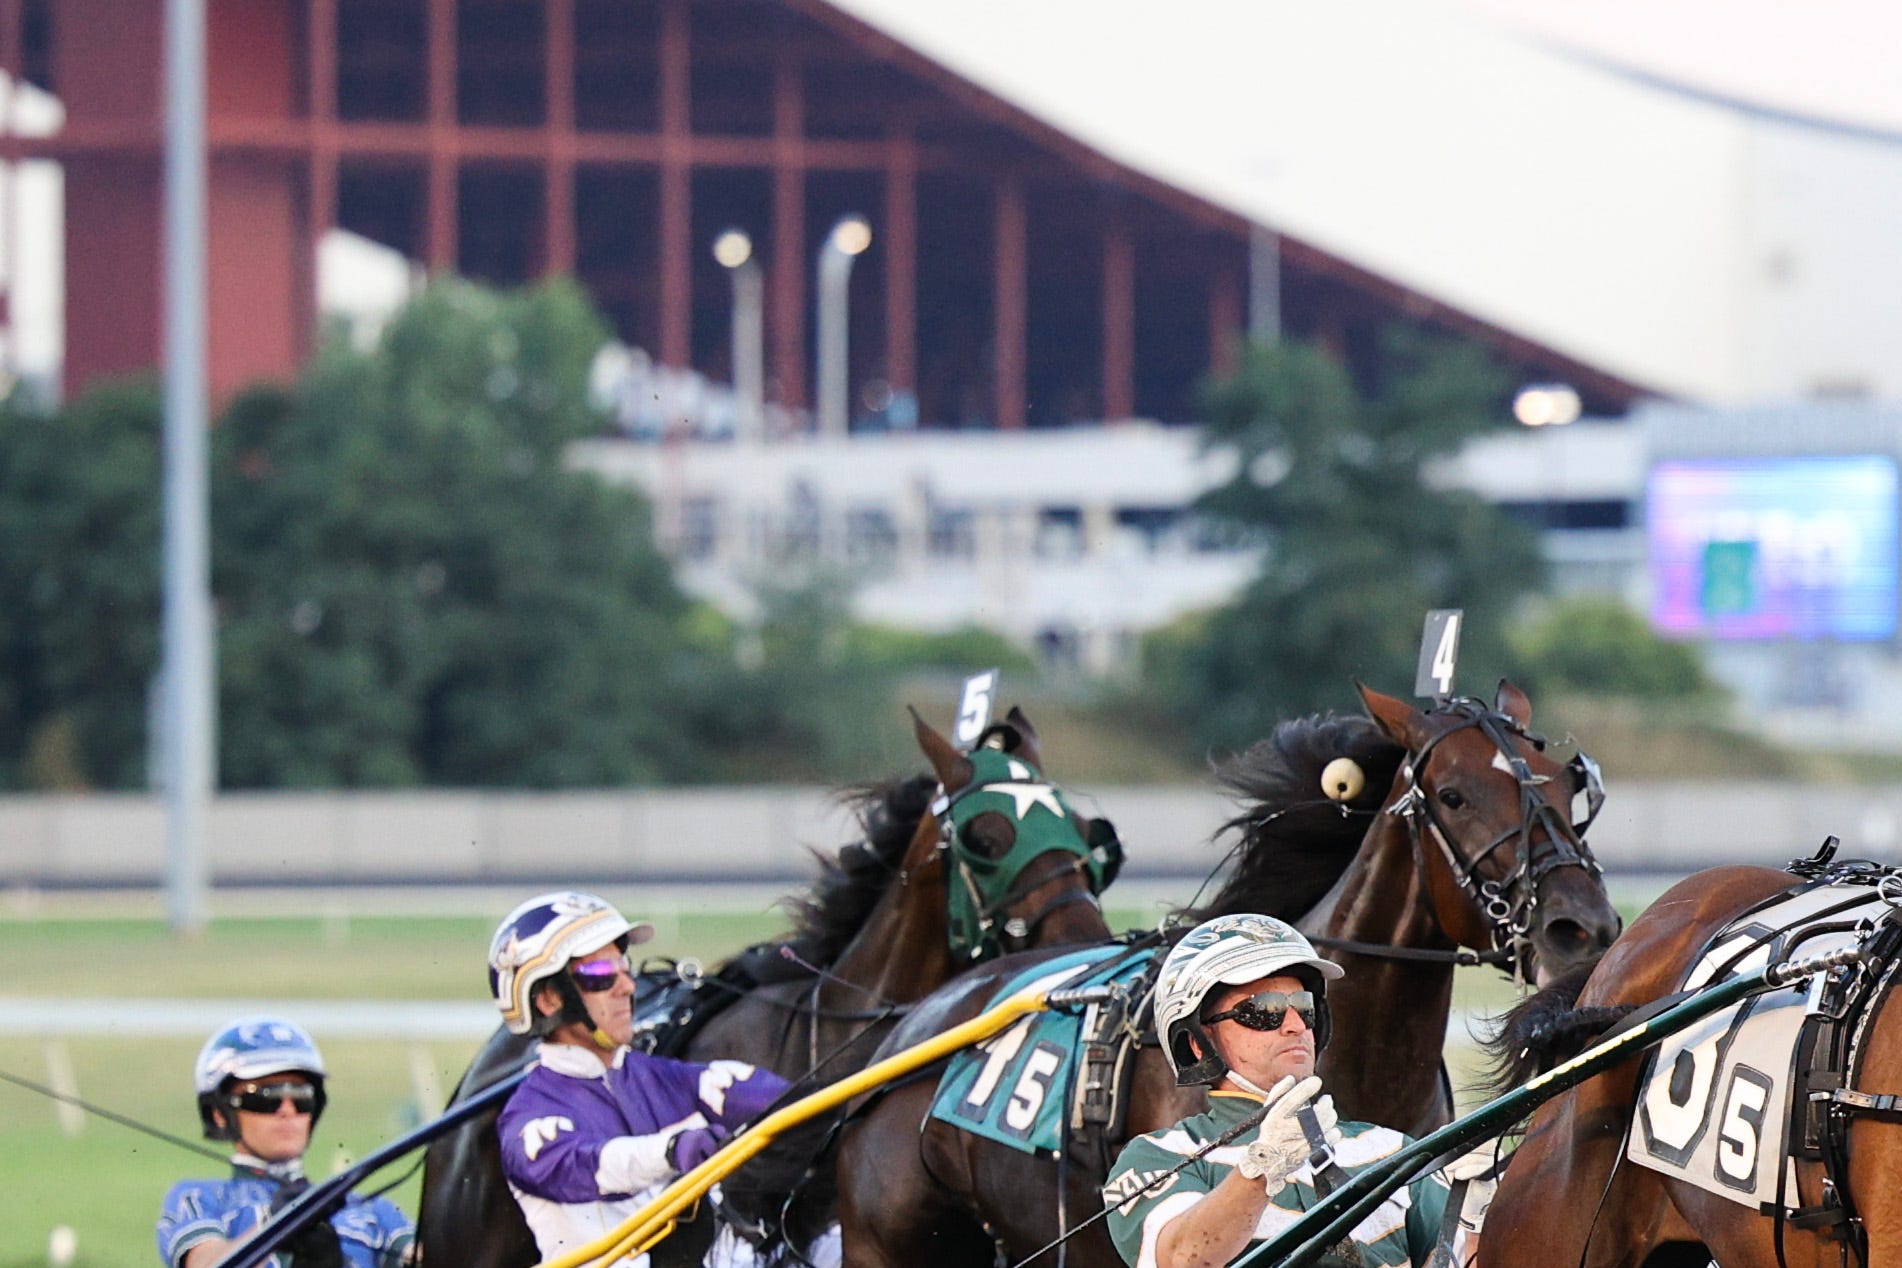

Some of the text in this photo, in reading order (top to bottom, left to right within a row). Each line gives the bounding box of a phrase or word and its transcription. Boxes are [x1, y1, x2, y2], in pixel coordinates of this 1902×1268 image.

[1431, 614, 1458, 694] 4
[958, 671, 994, 742] 5
[1005, 1047, 1060, 1132] 5
[1645, 932, 1772, 1181] 8 5
